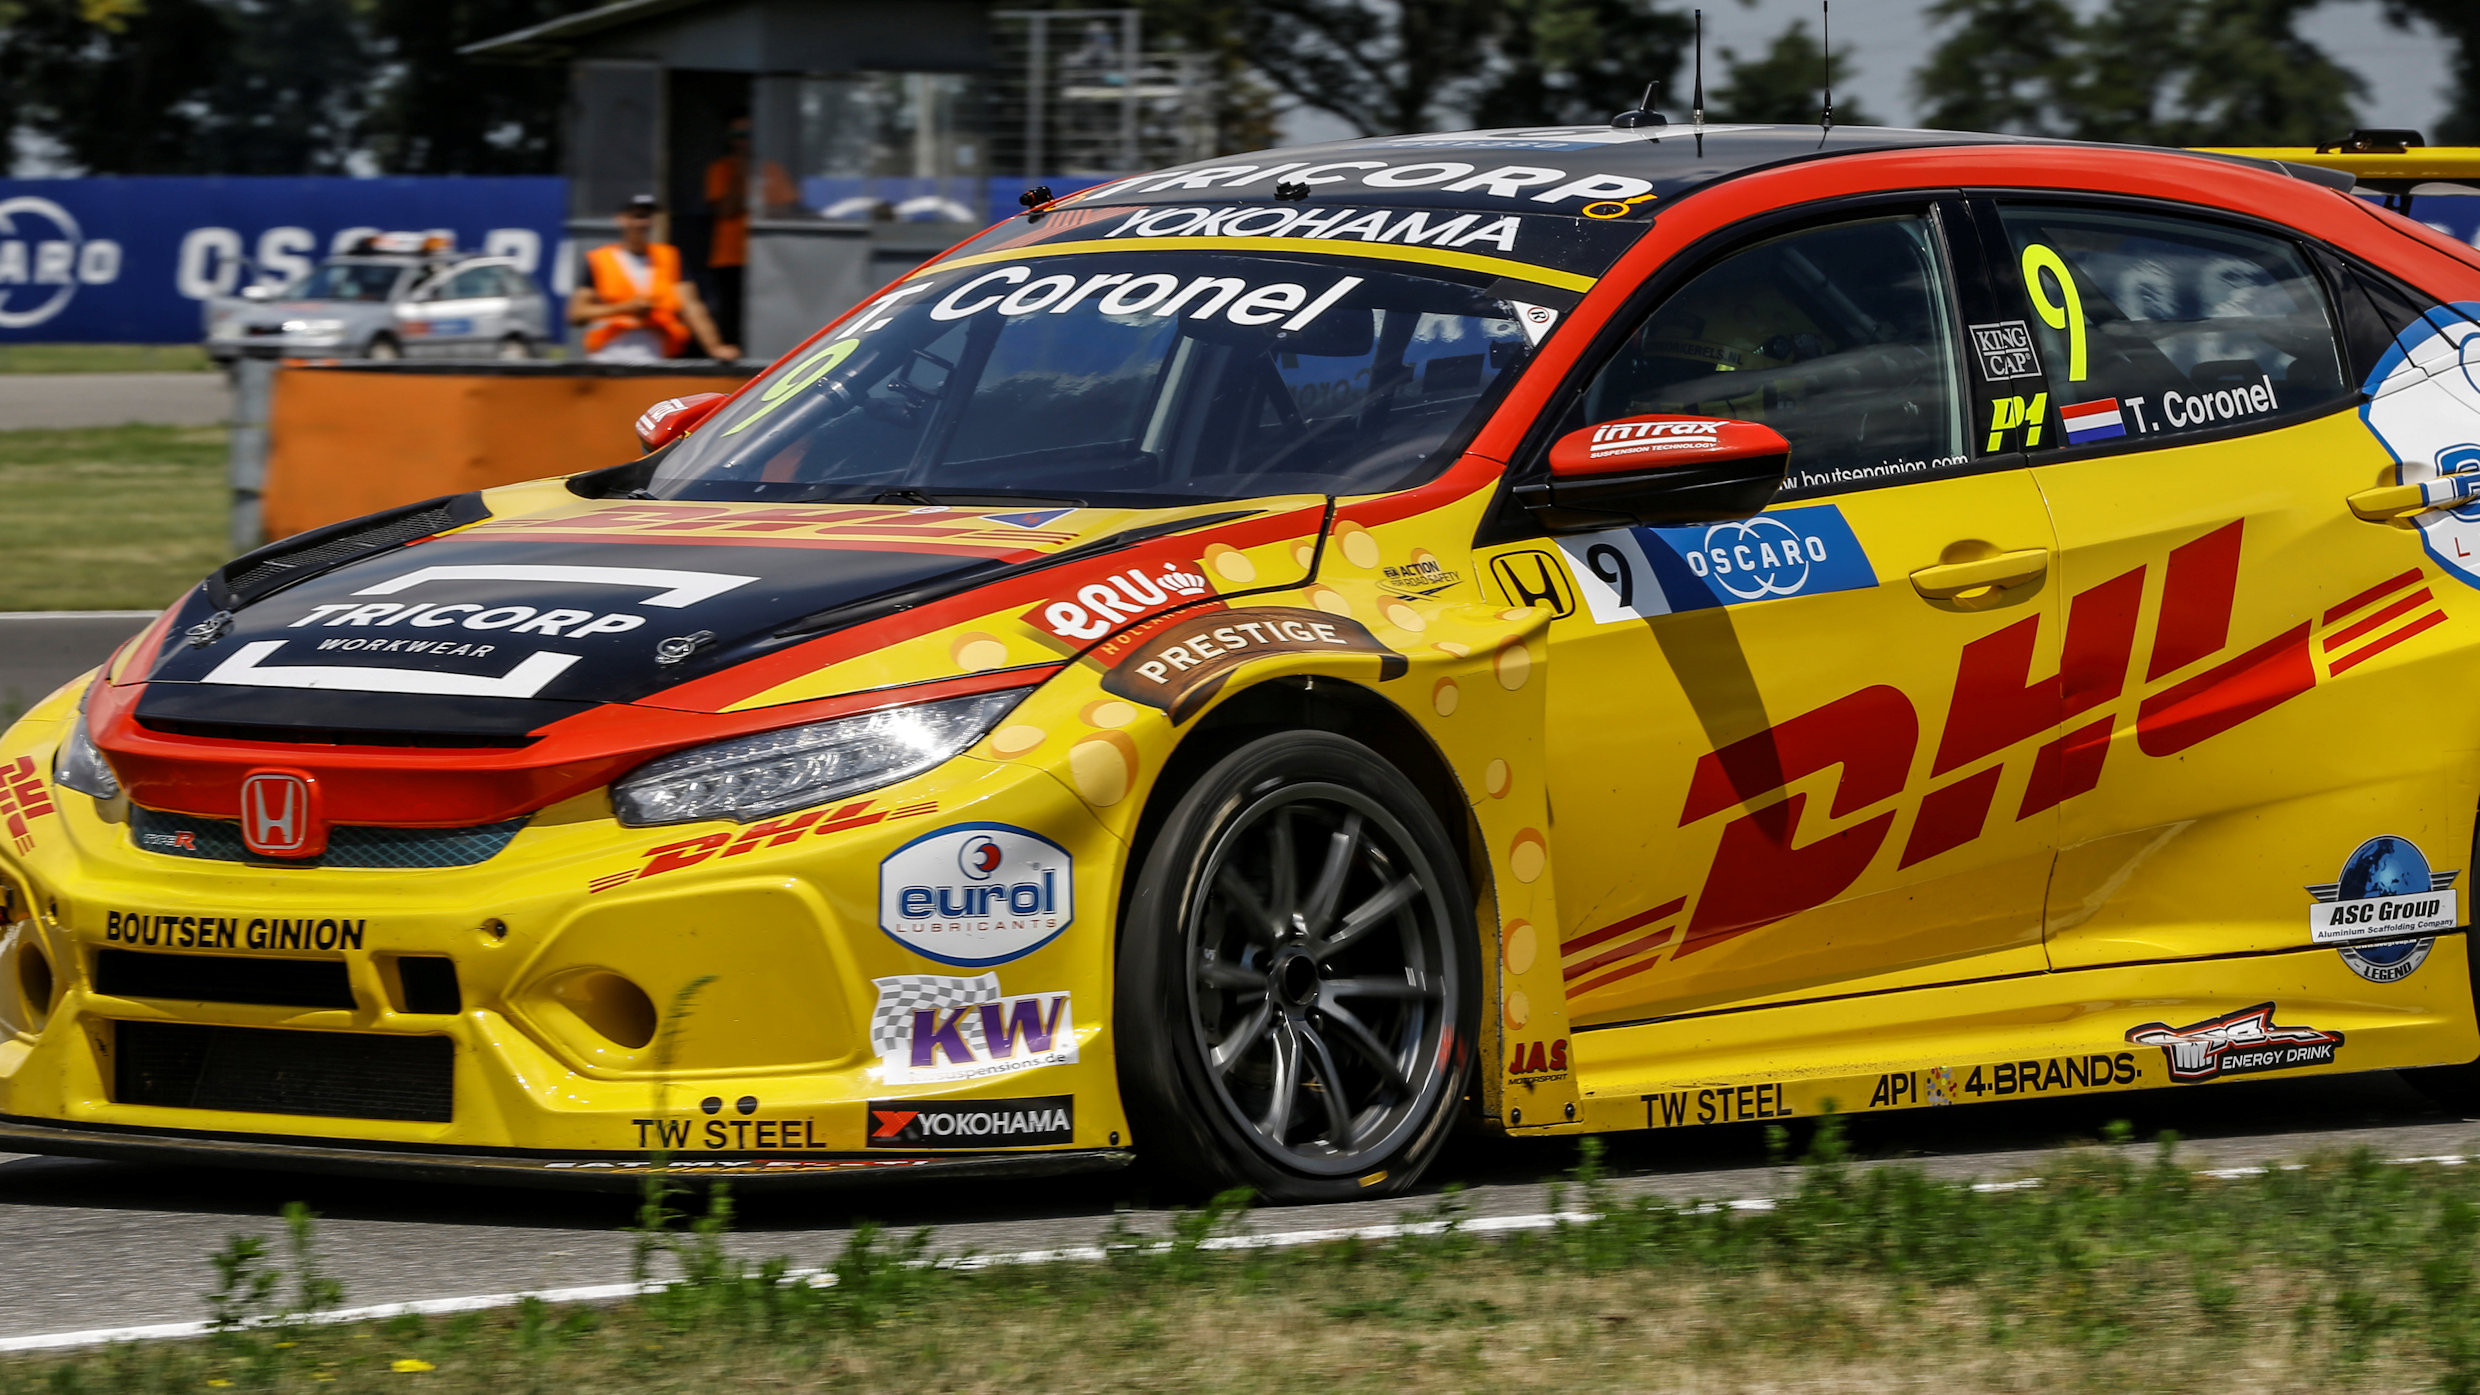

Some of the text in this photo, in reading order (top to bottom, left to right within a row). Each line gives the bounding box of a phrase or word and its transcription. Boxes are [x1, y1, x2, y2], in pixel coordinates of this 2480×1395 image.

[1085, 161, 1655, 203] TRICORP
[1103, 206, 1521, 252] YOKOHAMA
[835, 265, 1365, 341] T. Coronel
[2022, 244, 2087, 381] 9
[1976, 327, 2027, 352] KING
[720, 338, 860, 438] 9
[2126, 374, 2279, 434] T. Coronel
[1986, 392, 2048, 452] P1
[1590, 442, 1717, 459] SUSPENSION TECHNOLOGY
[1400, 561, 1440, 577] ACTION
[1586, 543, 1634, 608] 9
[1686, 536, 1828, 578] OSCARO
[1403, 576, 1429, 587] ROAD
[1427, 571, 1460, 584] SAFETY
[288, 603, 647, 639] TRICORP
[317, 638, 496, 658] WORKWEAR
[1135, 620, 1349, 684] PRESTIGE
[1672, 517, 2317, 959] DHL
[638, 801, 889, 879] DHL
[897, 868, 1057, 919] eurol
[2329, 899, 2440, 926] ASC Group
[106, 910, 366, 950] BOUTSEN GINION
[896, 918, 1058, 933] LUBRICANTS
[2317, 918, 2454, 939] Aluminium Scaffolding Company
[2363, 961, 2412, 981] LEGEND
[910, 996, 1068, 1069] KW
[2222, 1045, 2332, 1070] ENERGY DRINK
[1640, 1083, 1793, 1129] TW STEEL
[1868, 1071, 1918, 1108] API
[631, 1116, 828, 1150] TW STEEL
[918, 1108, 1072, 1136] YOKOHAMA
